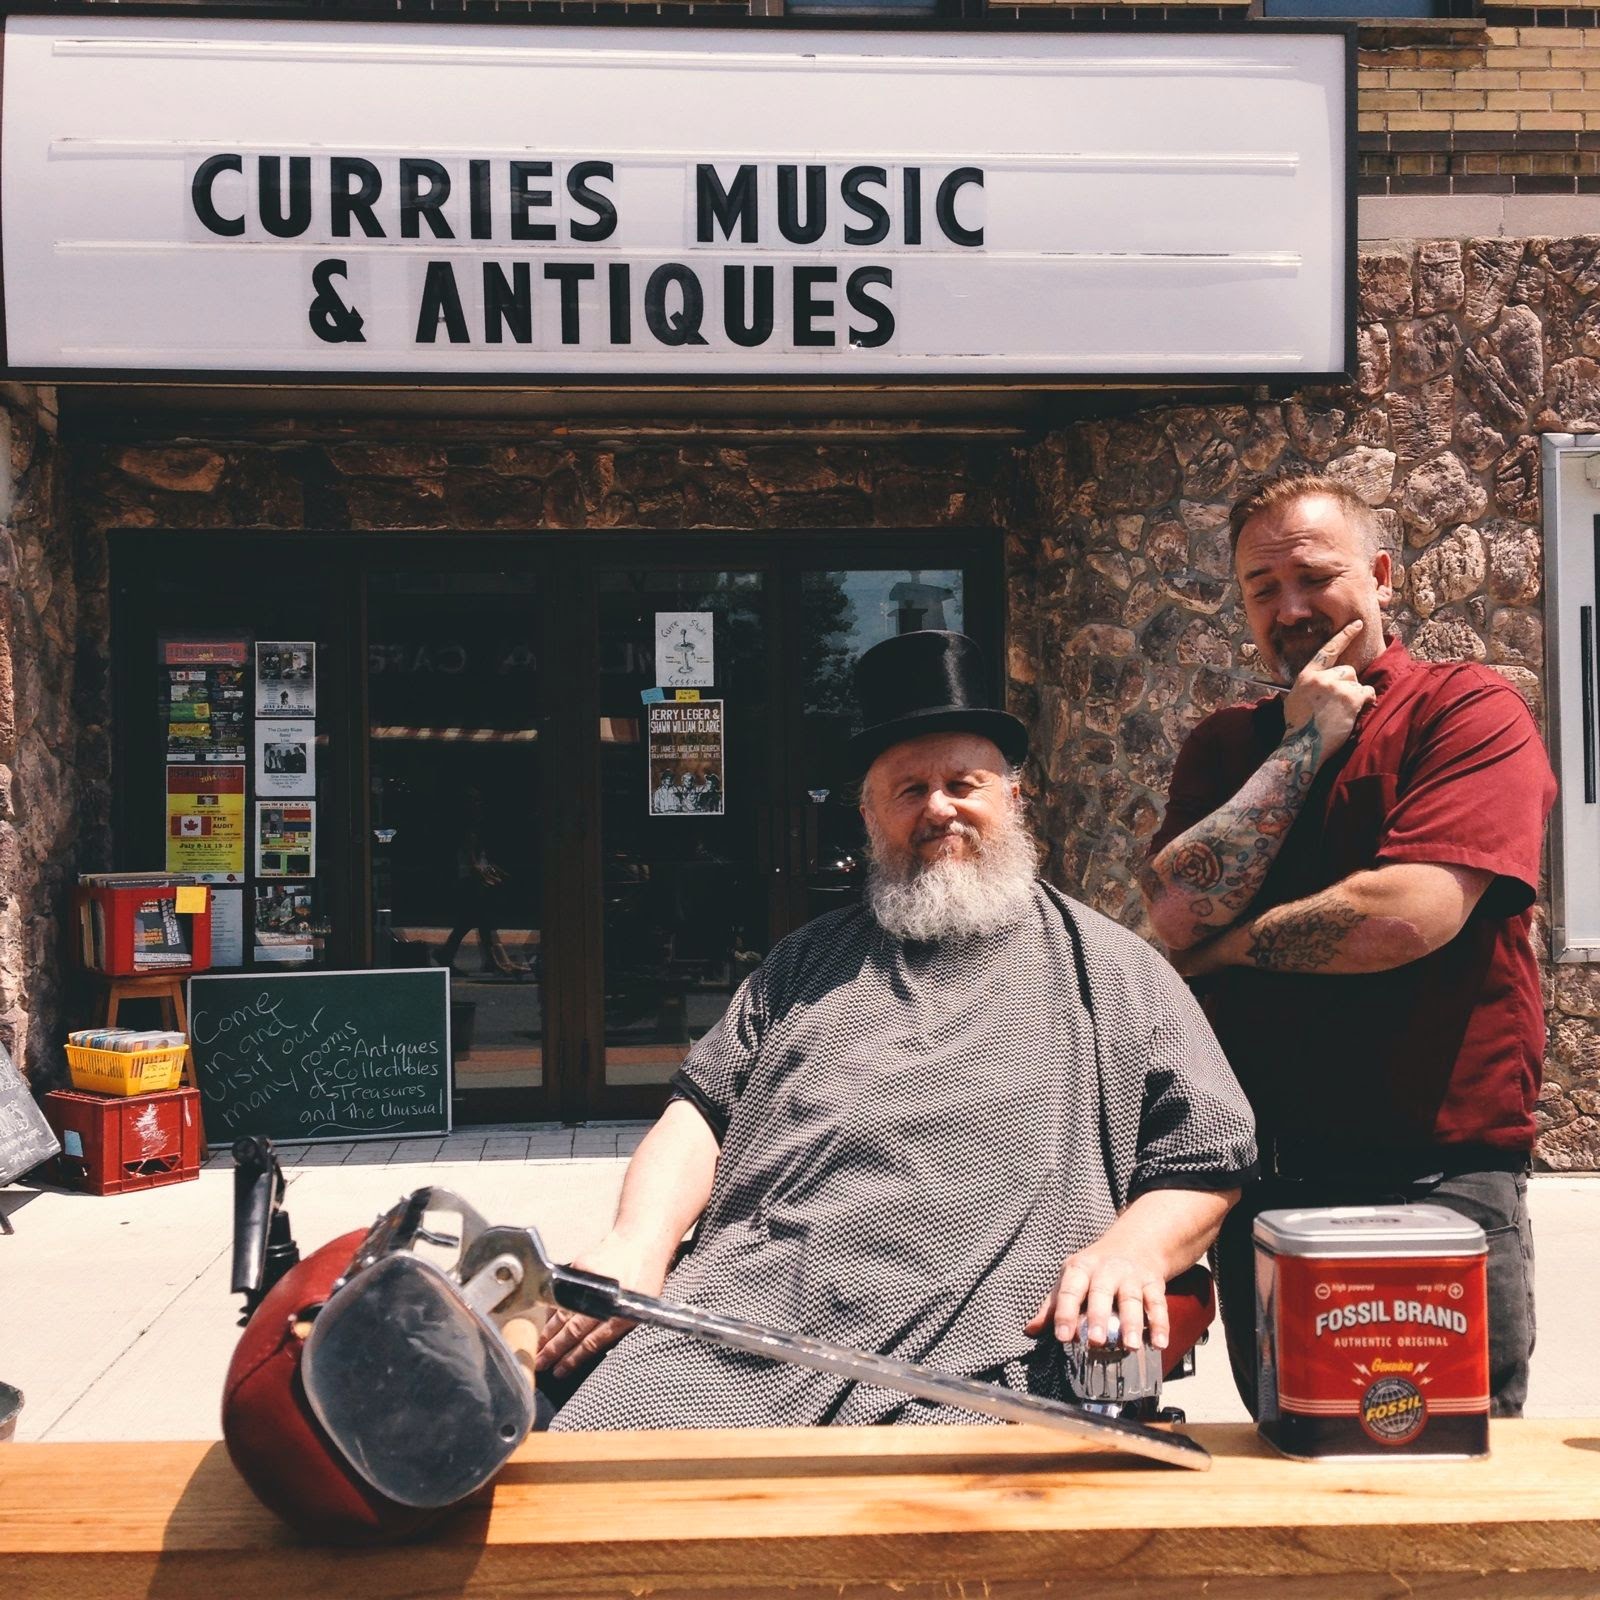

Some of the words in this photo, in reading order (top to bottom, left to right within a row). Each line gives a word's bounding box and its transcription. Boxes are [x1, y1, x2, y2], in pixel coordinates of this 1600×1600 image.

[192, 153, 618, 242] CURRIES
[697, 163, 984, 247] MUSIC
[308, 258, 367, 343] &
[415, 261, 896, 349] ANTIQUES
[650, 720, 671, 734] SHAWN
[672, 720, 697, 734] WILLIAM
[698, 719, 720, 733] CLARKE
[651, 709, 679, 720] JERRY
[681, 708, 710, 720] LEGER
[712, 708, 720, 720] &
[194, 992, 283, 1045] Come
[282, 1006, 326, 1055] our
[205, 1051, 236, 1075] in
[240, 1010, 298, 1054] and
[353, 1035, 440, 1071] Antiques
[222, 1067, 299, 1128] many
[301, 1021, 357, 1073] rooms
[309, 1067, 328, 1099] of
[334, 1056, 439, 1081] Collectibles
[300, 1101, 336, 1124] and
[381, 1088, 443, 1117] Unusual
[331, 1082, 426, 1101] Treasures
[1316, 1300, 1391, 1337] FOSSIL
[1393, 1299, 1467, 1335] BRAND
[1334, 1336, 1392, 1348] AUTHENTIC
[1397, 1336, 1449, 1348] ORIGINAL
[1371, 1357, 1415, 1373] Genuine
[1366, 1395, 1423, 1423] FOSSIL
